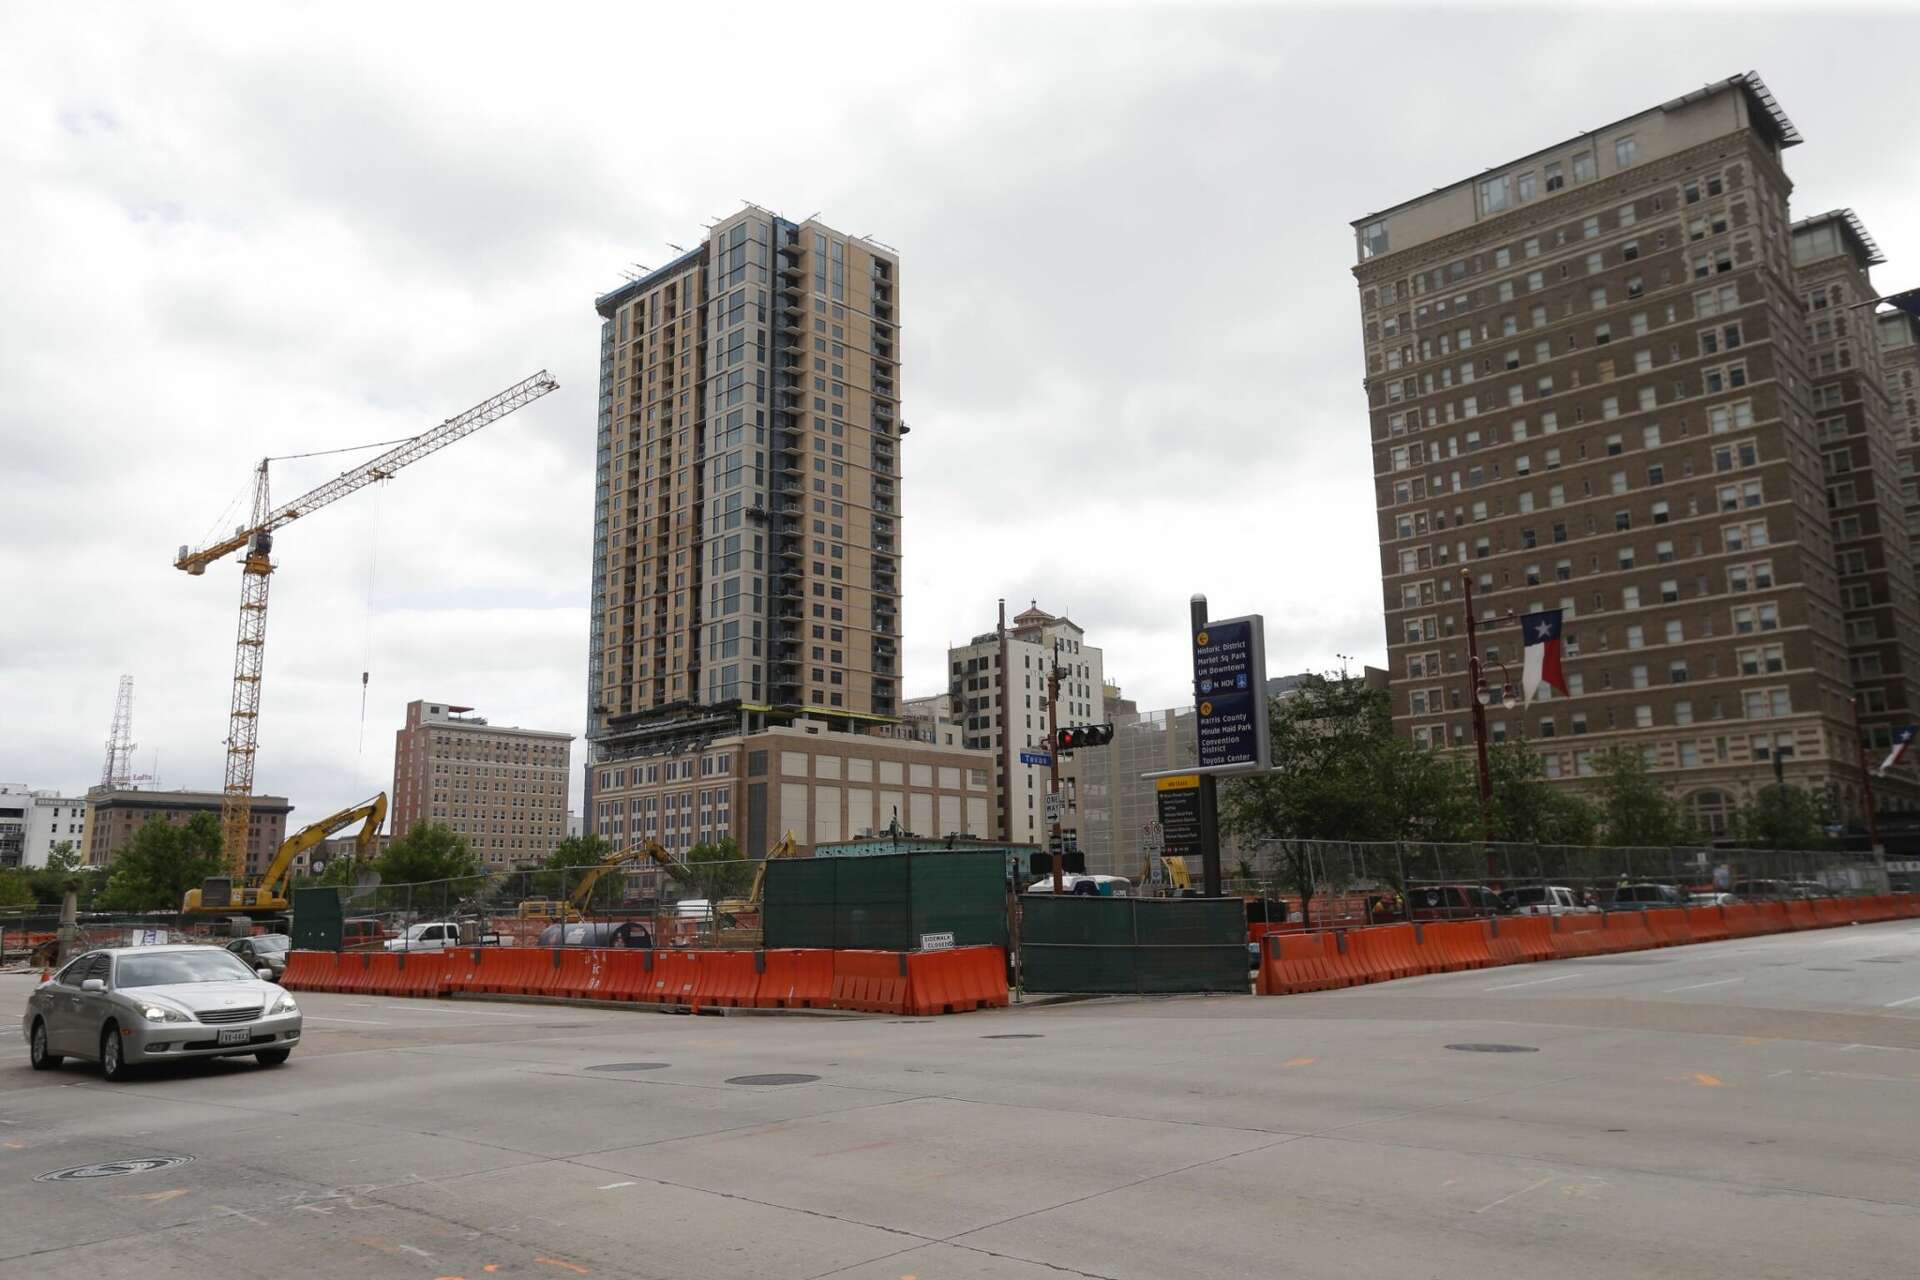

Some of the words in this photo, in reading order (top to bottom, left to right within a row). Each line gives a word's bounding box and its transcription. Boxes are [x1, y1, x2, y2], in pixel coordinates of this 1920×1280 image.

[1197, 645, 1221, 655] Historic
[1223, 641, 1246, 651] District
[1198, 656, 1219, 665] Market
[1220, 654, 1229, 663] Sq
[1231, 652, 1246, 660] Park
[1209, 664, 1245, 674] Downtown
[1201, 716, 1221, 725] Harris
[1222, 713, 1247, 723] County
[1201, 727, 1221, 735] Minute
[1221, 724, 1237, 733] Maid
[1237, 722, 1252, 732] Park
[1202, 736, 1240, 746] Convention
[1202, 745, 1226, 754] District
[1024, 755, 1047, 765] Texas
[1203, 756, 1225, 766] Toyota
[1227, 754, 1251, 763] Center
